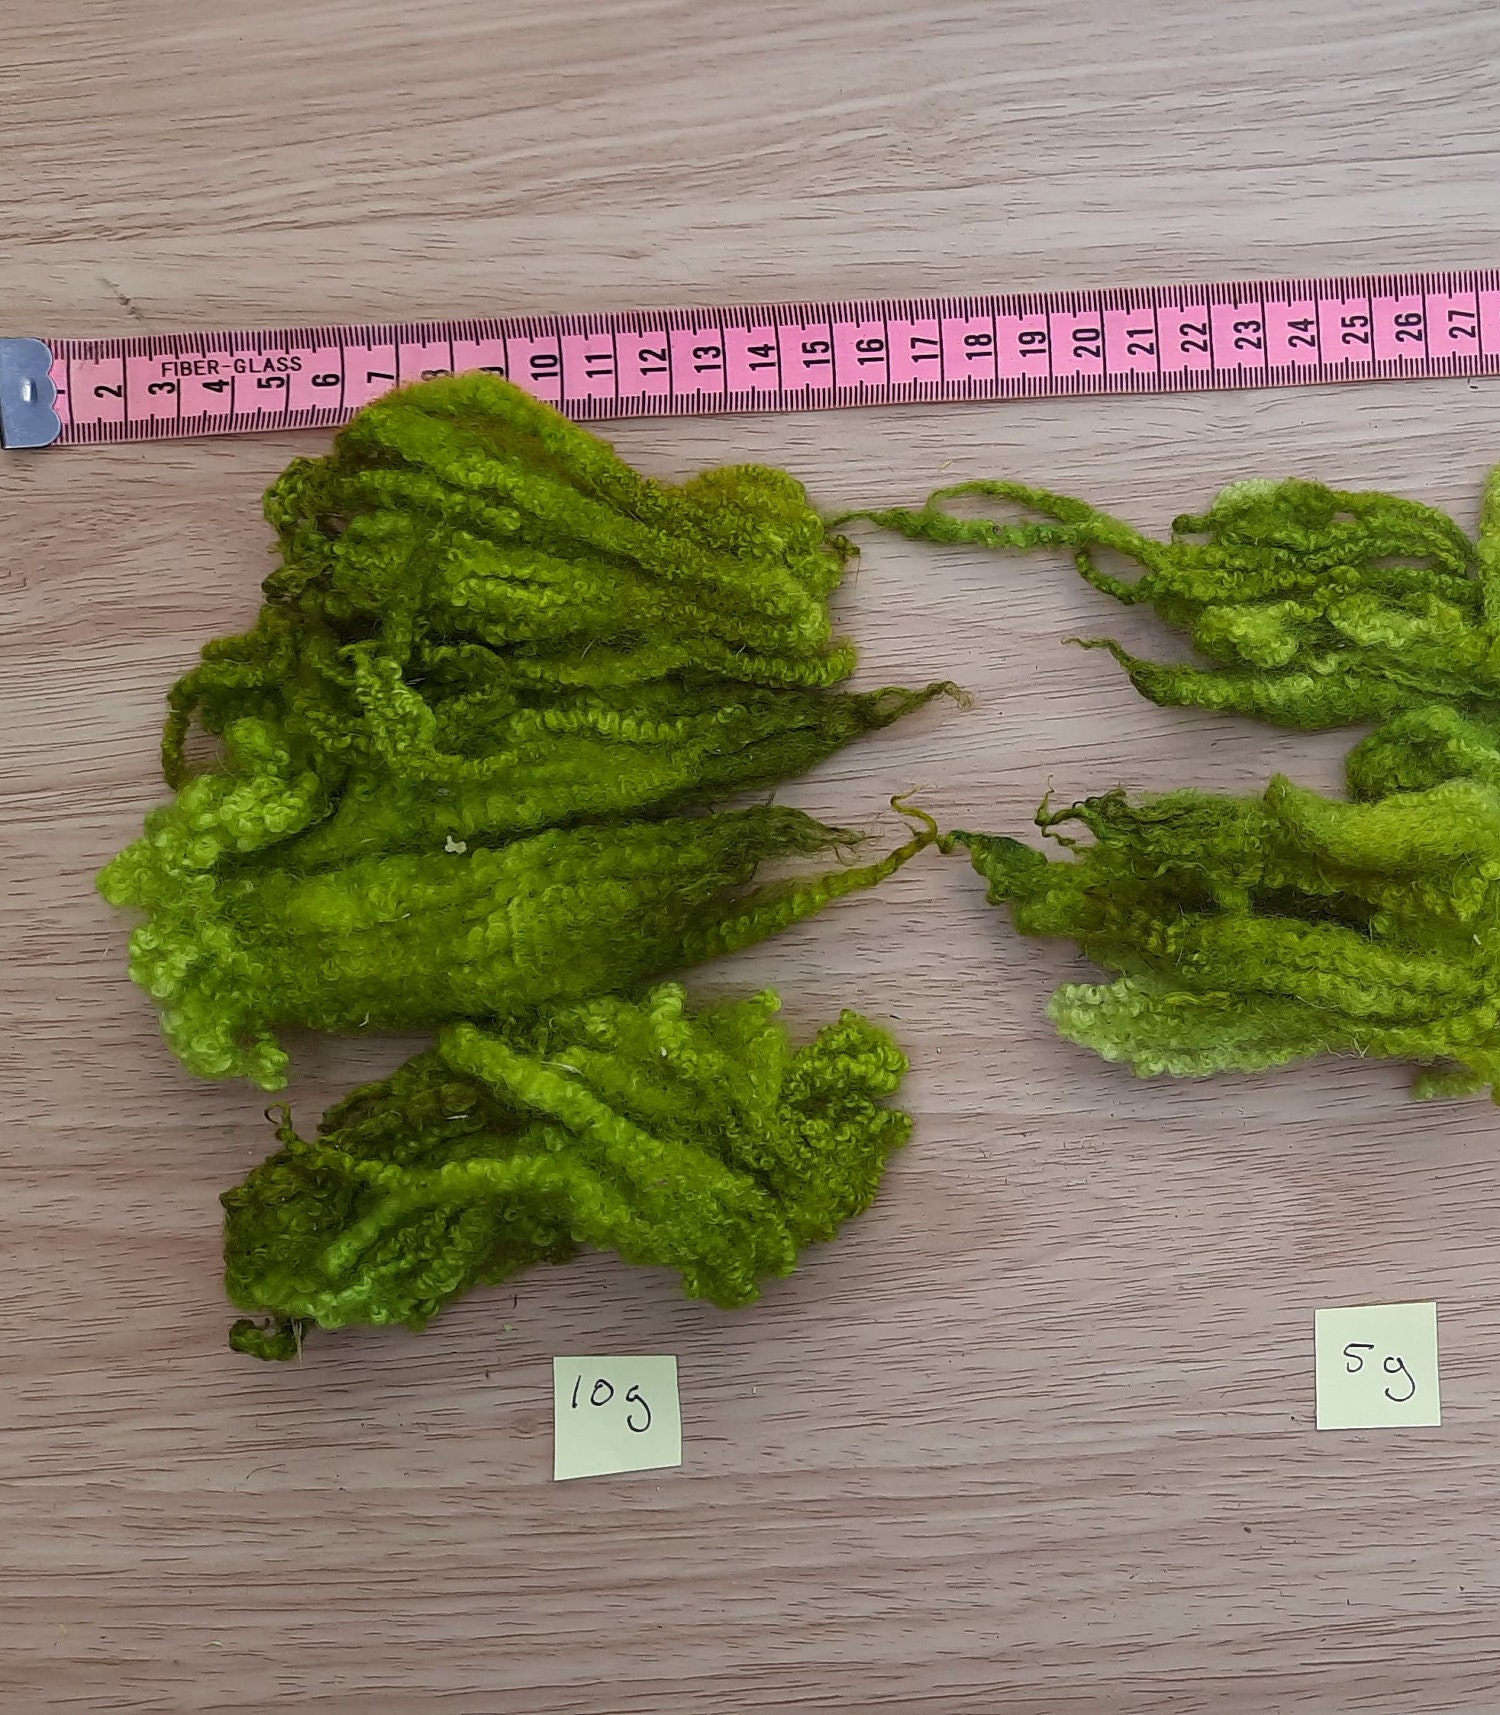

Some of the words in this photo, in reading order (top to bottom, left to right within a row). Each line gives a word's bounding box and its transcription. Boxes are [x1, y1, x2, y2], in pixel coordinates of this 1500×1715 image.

[1180, 323, 1208, 352] 22
[1233, 321, 1262, 349] 23
[1288, 319, 1315, 347] 24
[1341, 316, 1369, 344] 25
[1395, 313, 1422, 342] 26
[1448, 311, 1476, 338] 27
[802, 341, 830, 368] 15
[856, 339, 884, 365] 16
[911, 337, 938, 362] 17
[964, 334, 992, 360] 18
[1018, 332, 1046, 357] 19
[1073, 328, 1100, 357] 20
[1127, 329, 1154, 355] 21
[161, 356, 302, 377] FIBER-GLASS
[530, 355, 558, 381] 10
[585, 354, 613, 378] 11
[639, 349, 667, 375] 12
[693, 346, 721, 373] 13
[748, 344, 776, 371] 14
[148, 381, 176, 395] 3
[202, 379, 229, 393] 4
[257, 376, 285, 388] 5
[311, 374, 340, 387] 6
[367, 372, 394, 383] 7
[94, 385, 122, 398] 2
[1343, 1343, 1416, 1402] 5g
[571, 1374, 652, 1433] 10g
